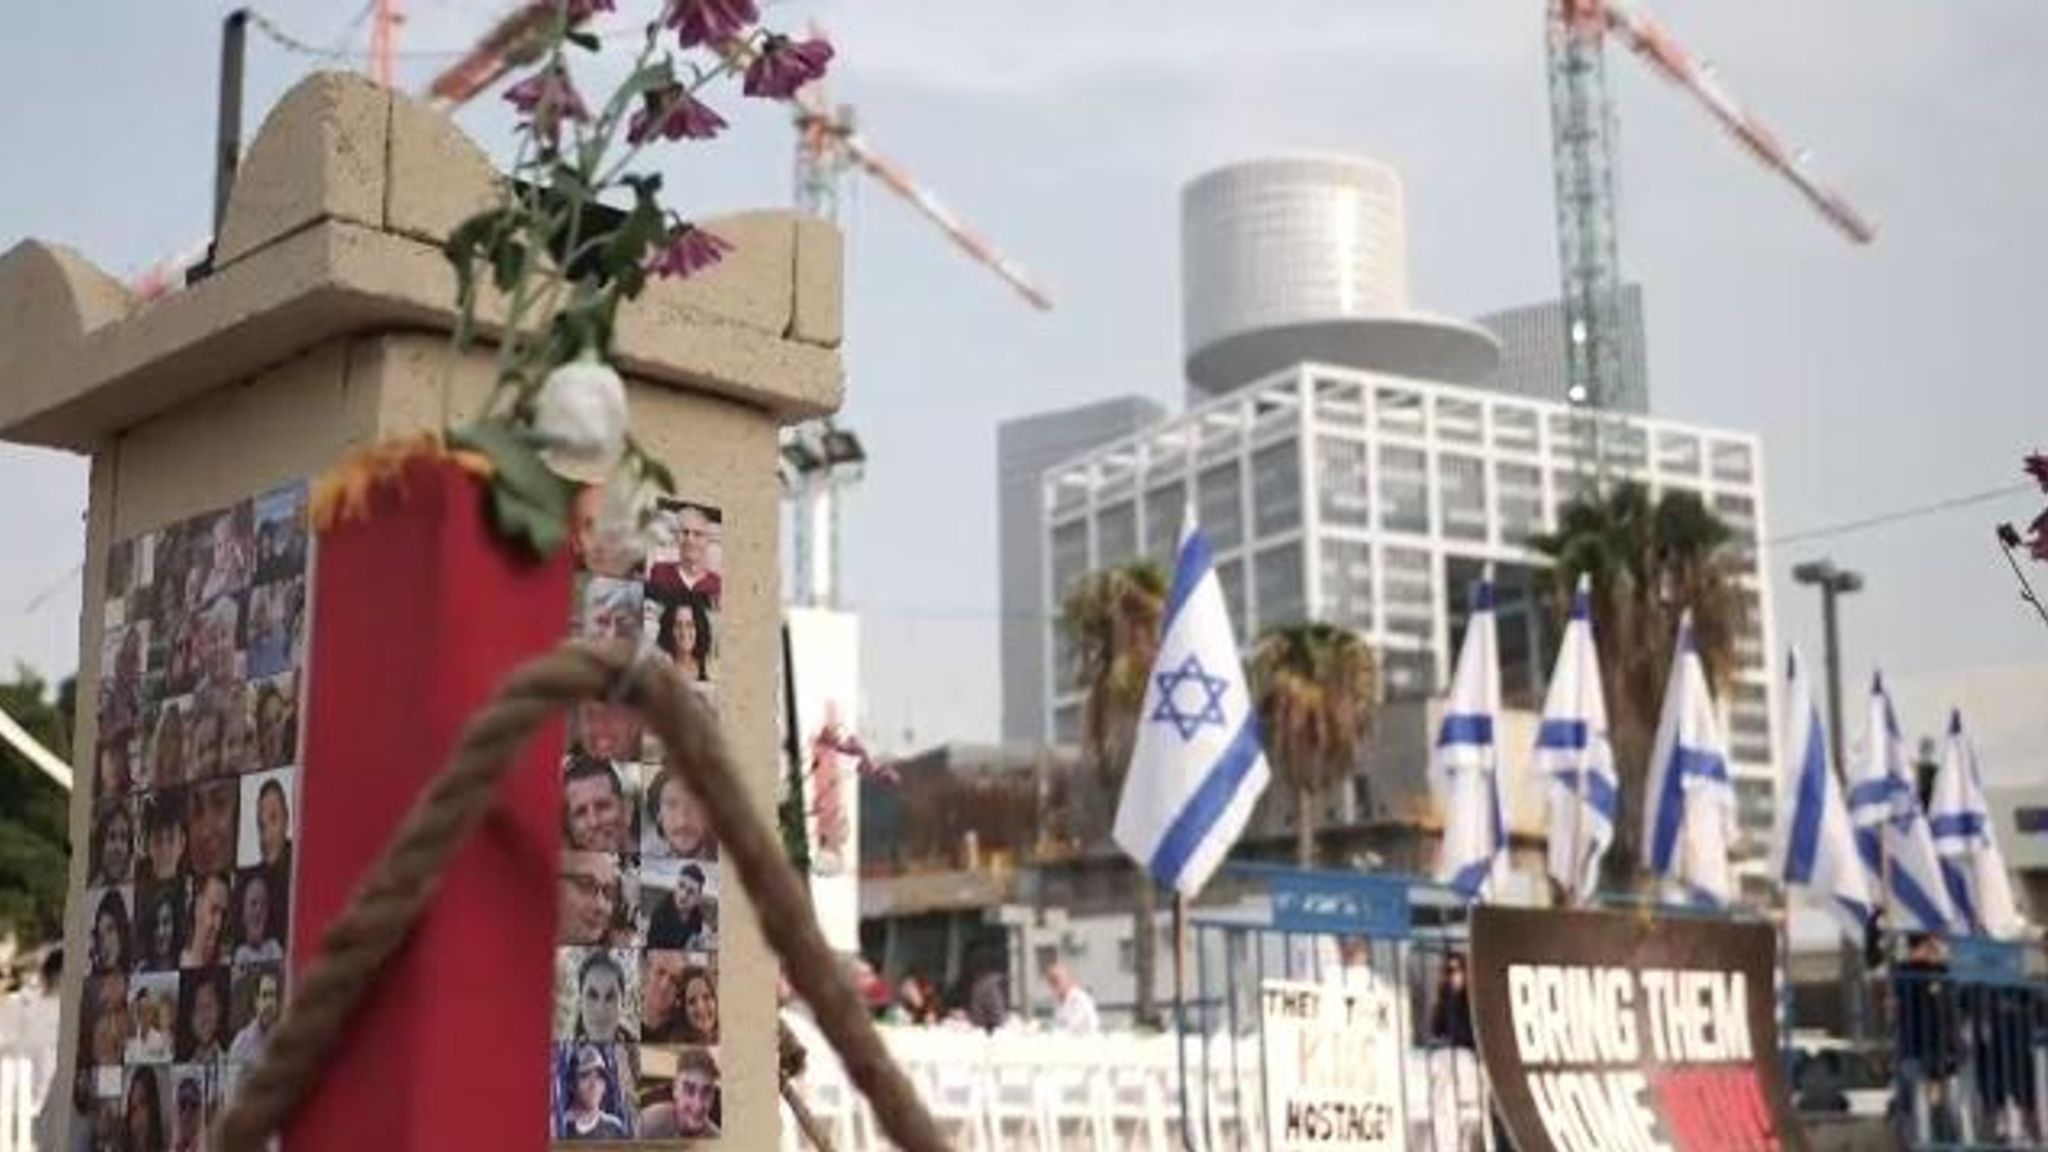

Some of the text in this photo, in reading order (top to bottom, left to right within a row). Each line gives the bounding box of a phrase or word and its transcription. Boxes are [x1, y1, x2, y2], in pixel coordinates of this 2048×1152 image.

[1342, 995, 1391, 1033] TK
[1508, 964, 1752, 1064] BRING THEM
[1527, 1071, 1675, 1152] HOME
